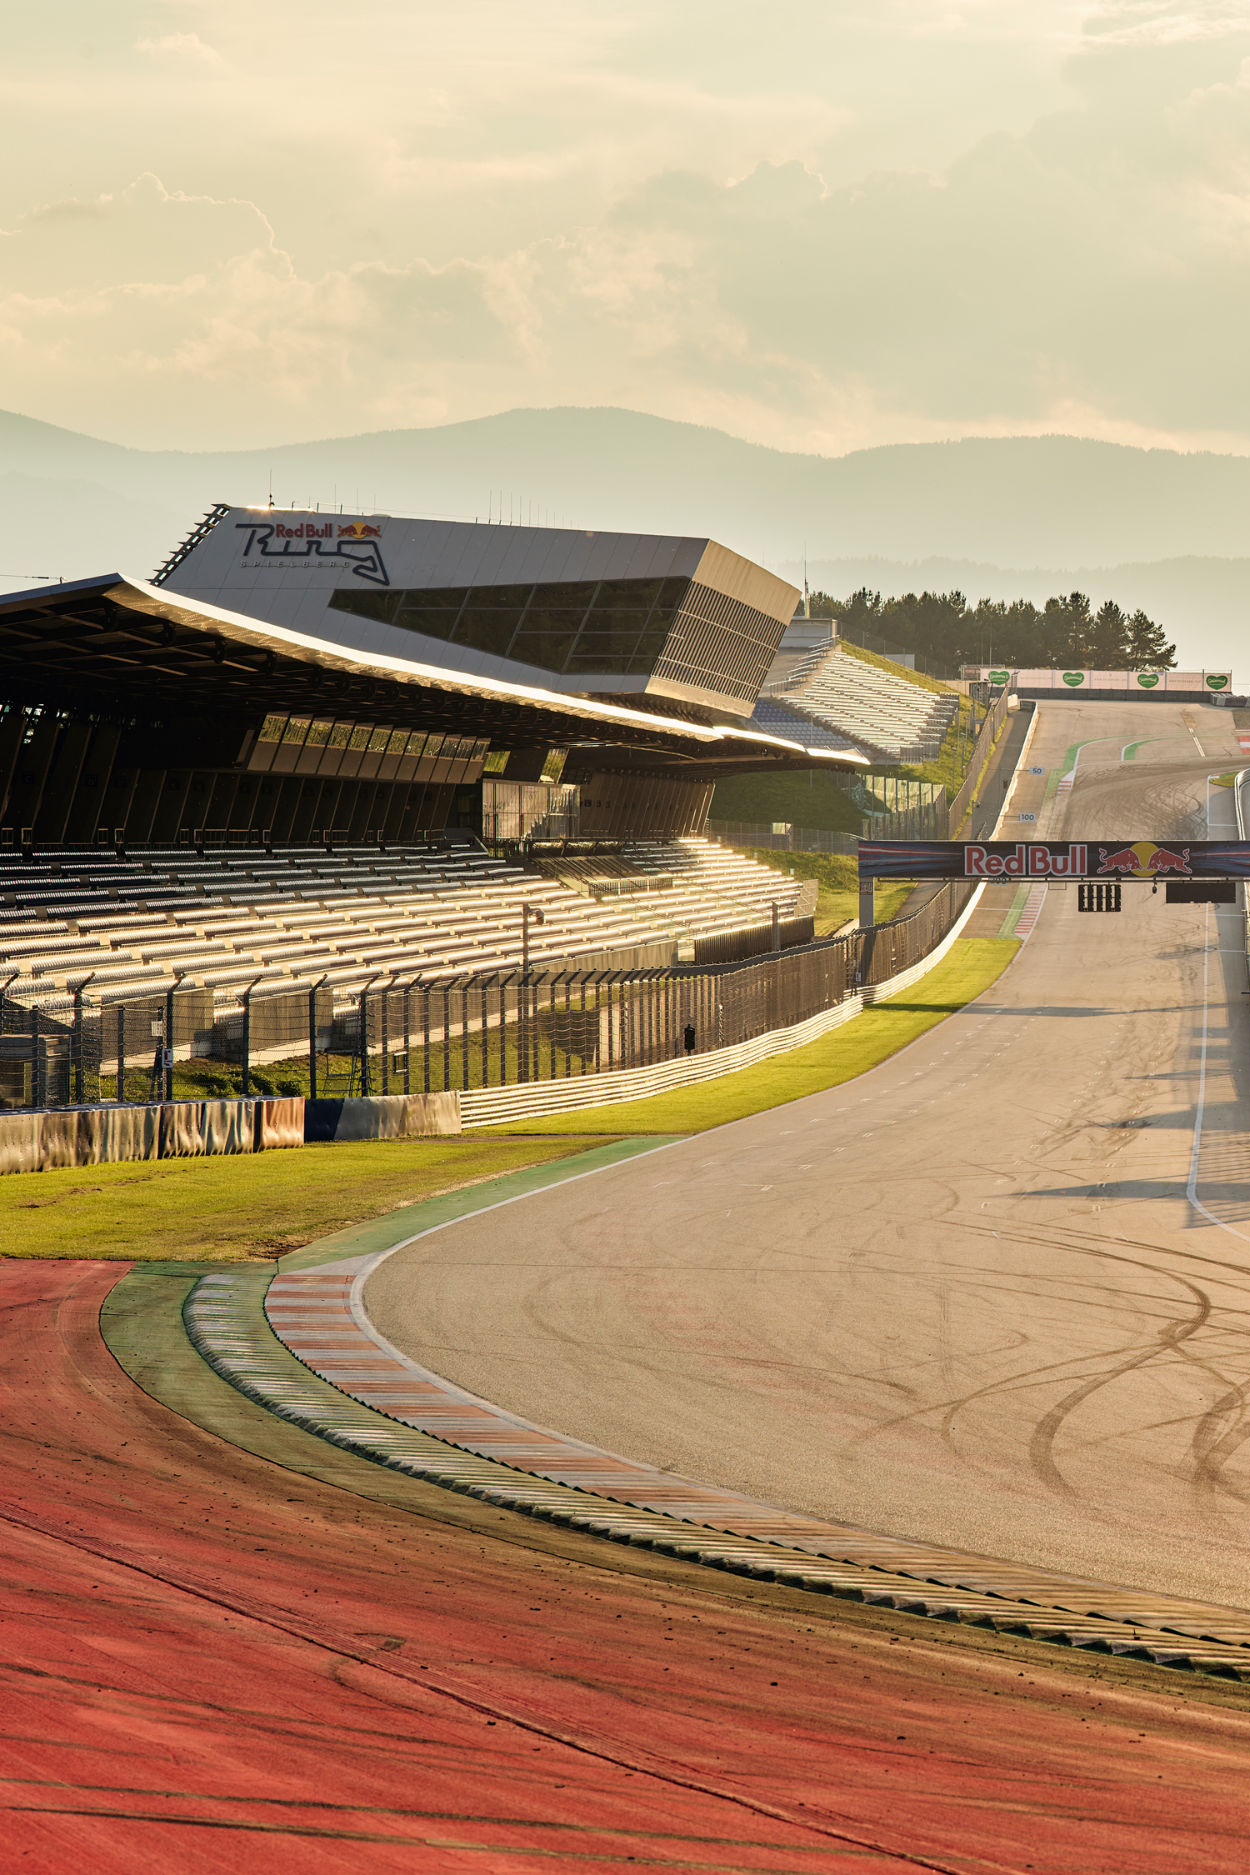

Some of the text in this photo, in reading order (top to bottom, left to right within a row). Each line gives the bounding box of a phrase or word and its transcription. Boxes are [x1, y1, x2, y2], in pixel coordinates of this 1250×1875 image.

[276, 523, 333, 538] Red Bull
[964, 844, 1088, 876] Red Bull
